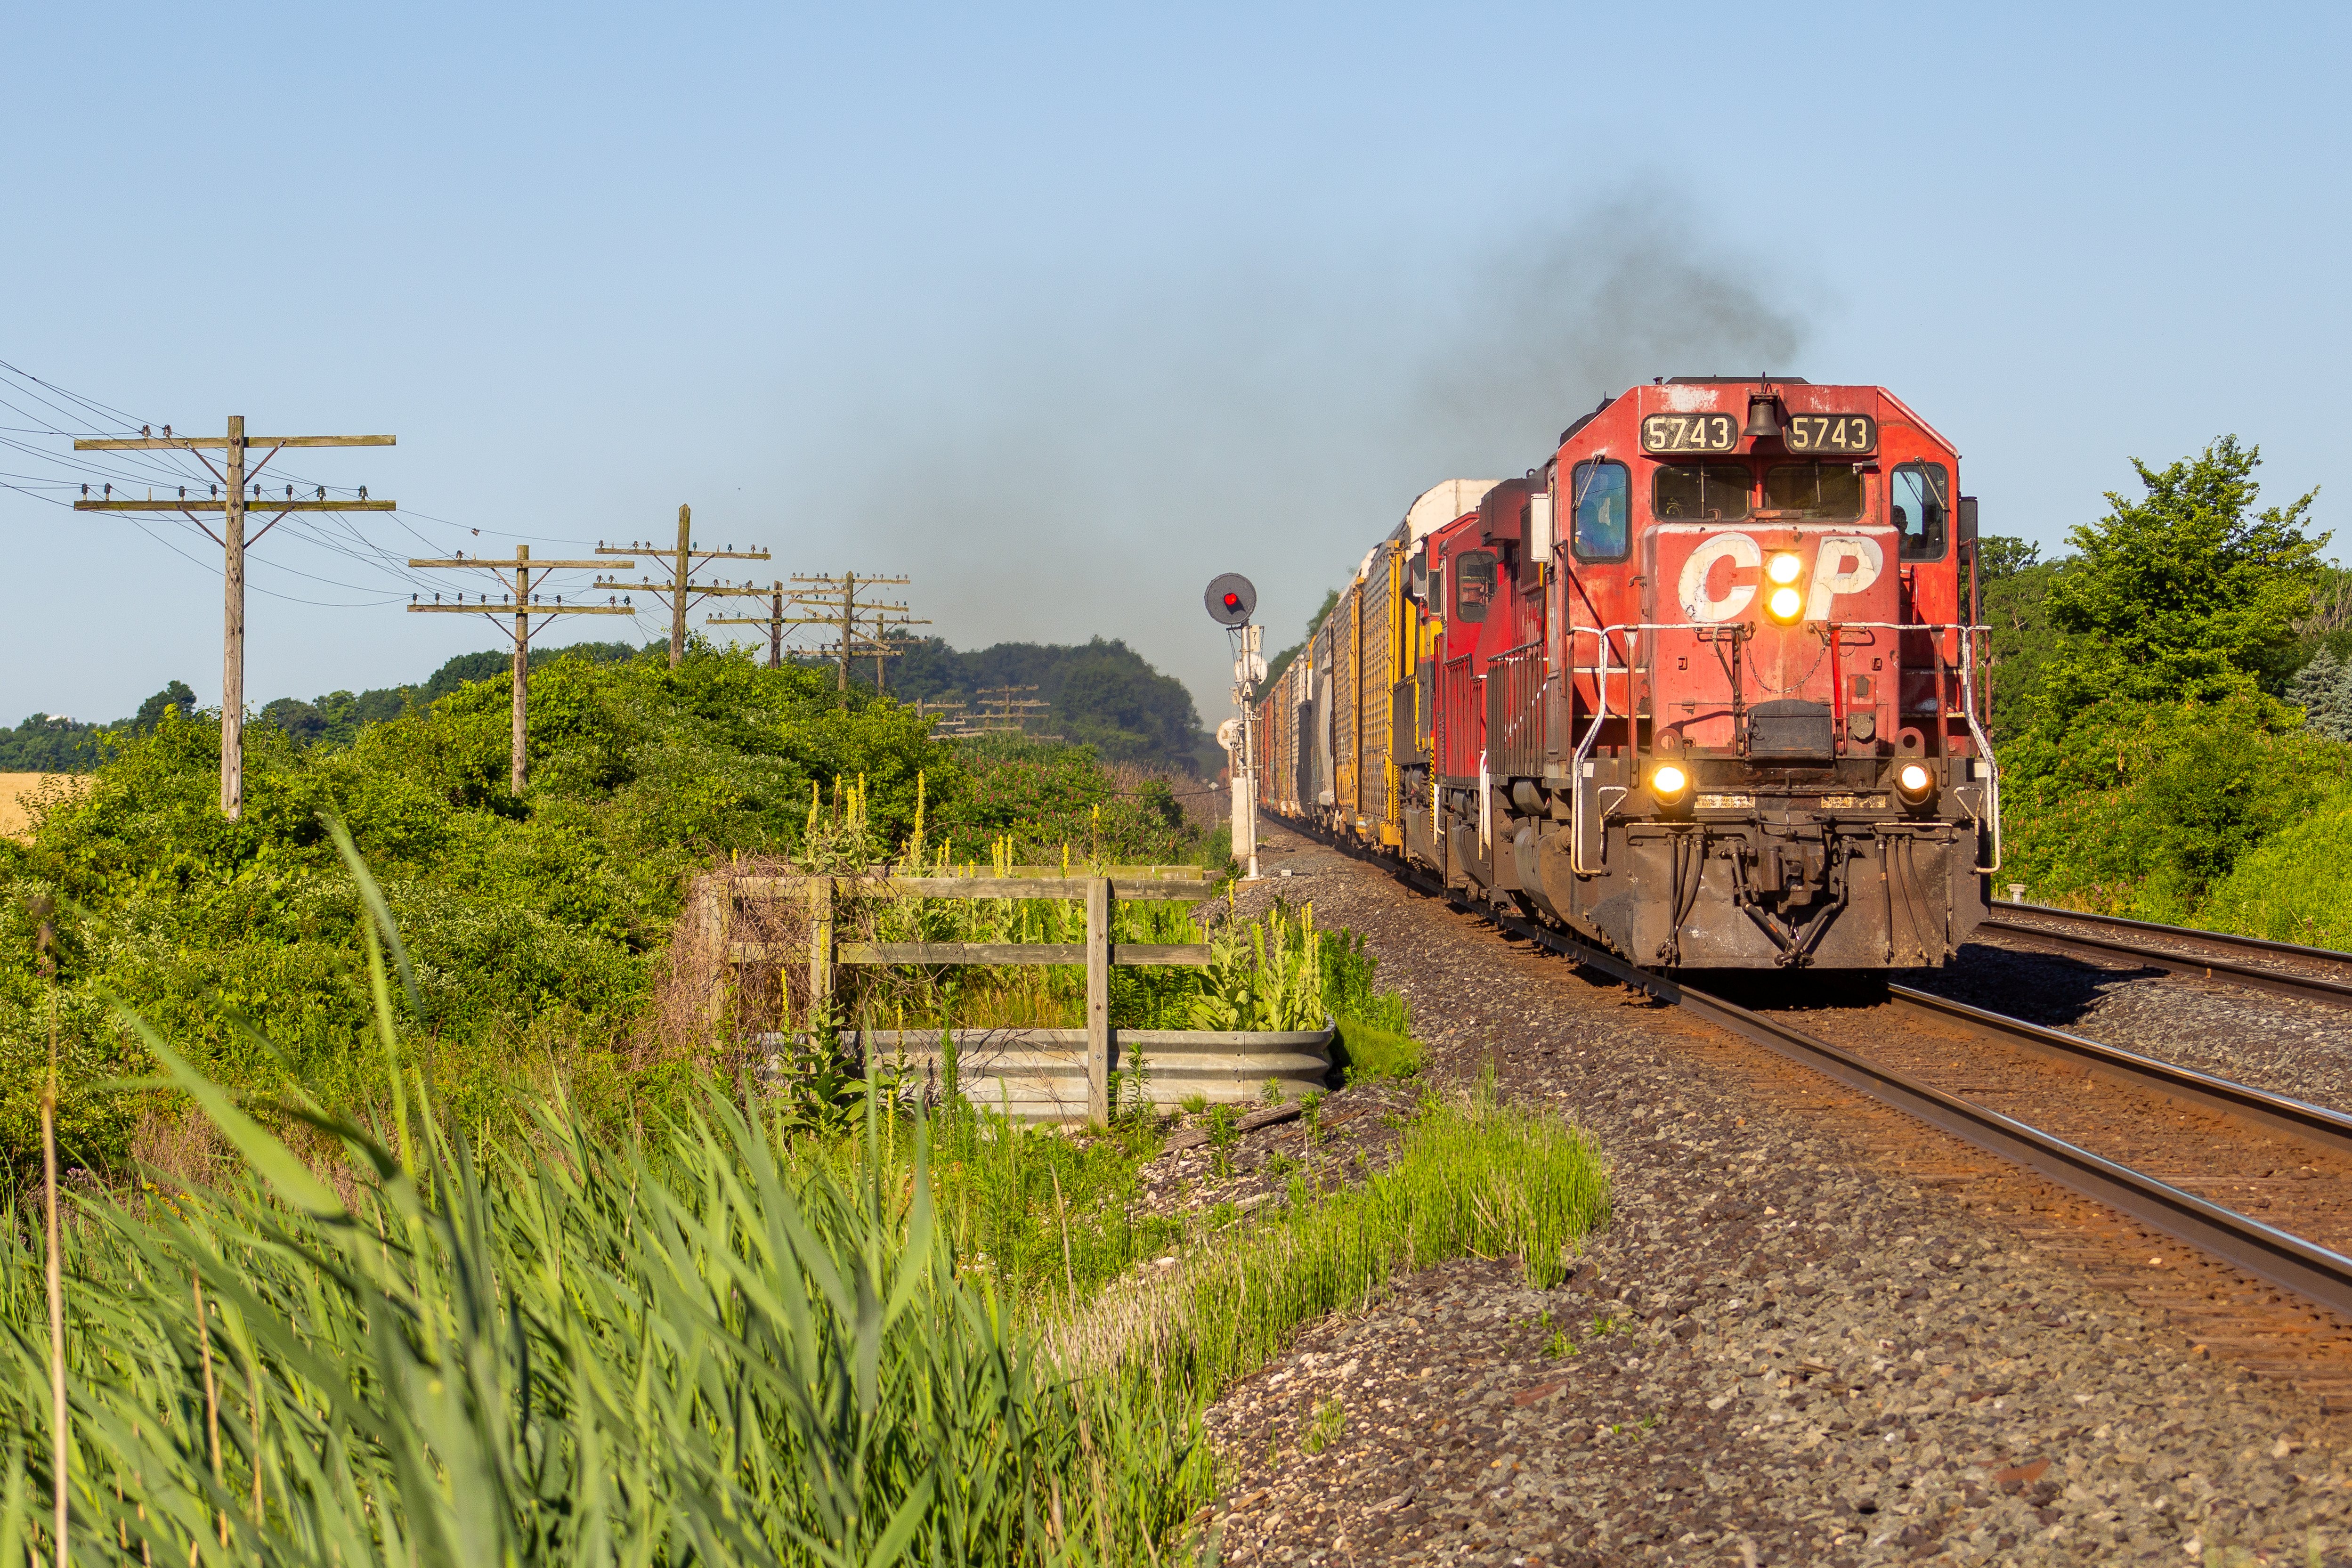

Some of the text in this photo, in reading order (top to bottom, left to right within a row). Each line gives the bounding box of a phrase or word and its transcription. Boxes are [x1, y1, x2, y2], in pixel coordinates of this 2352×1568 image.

[1649, 417, 1729, 448] 5743
[1792, 417, 1867, 448] 5743
[1678, 532, 1883, 623] CP
[1241, 681, 1253, 697] A
